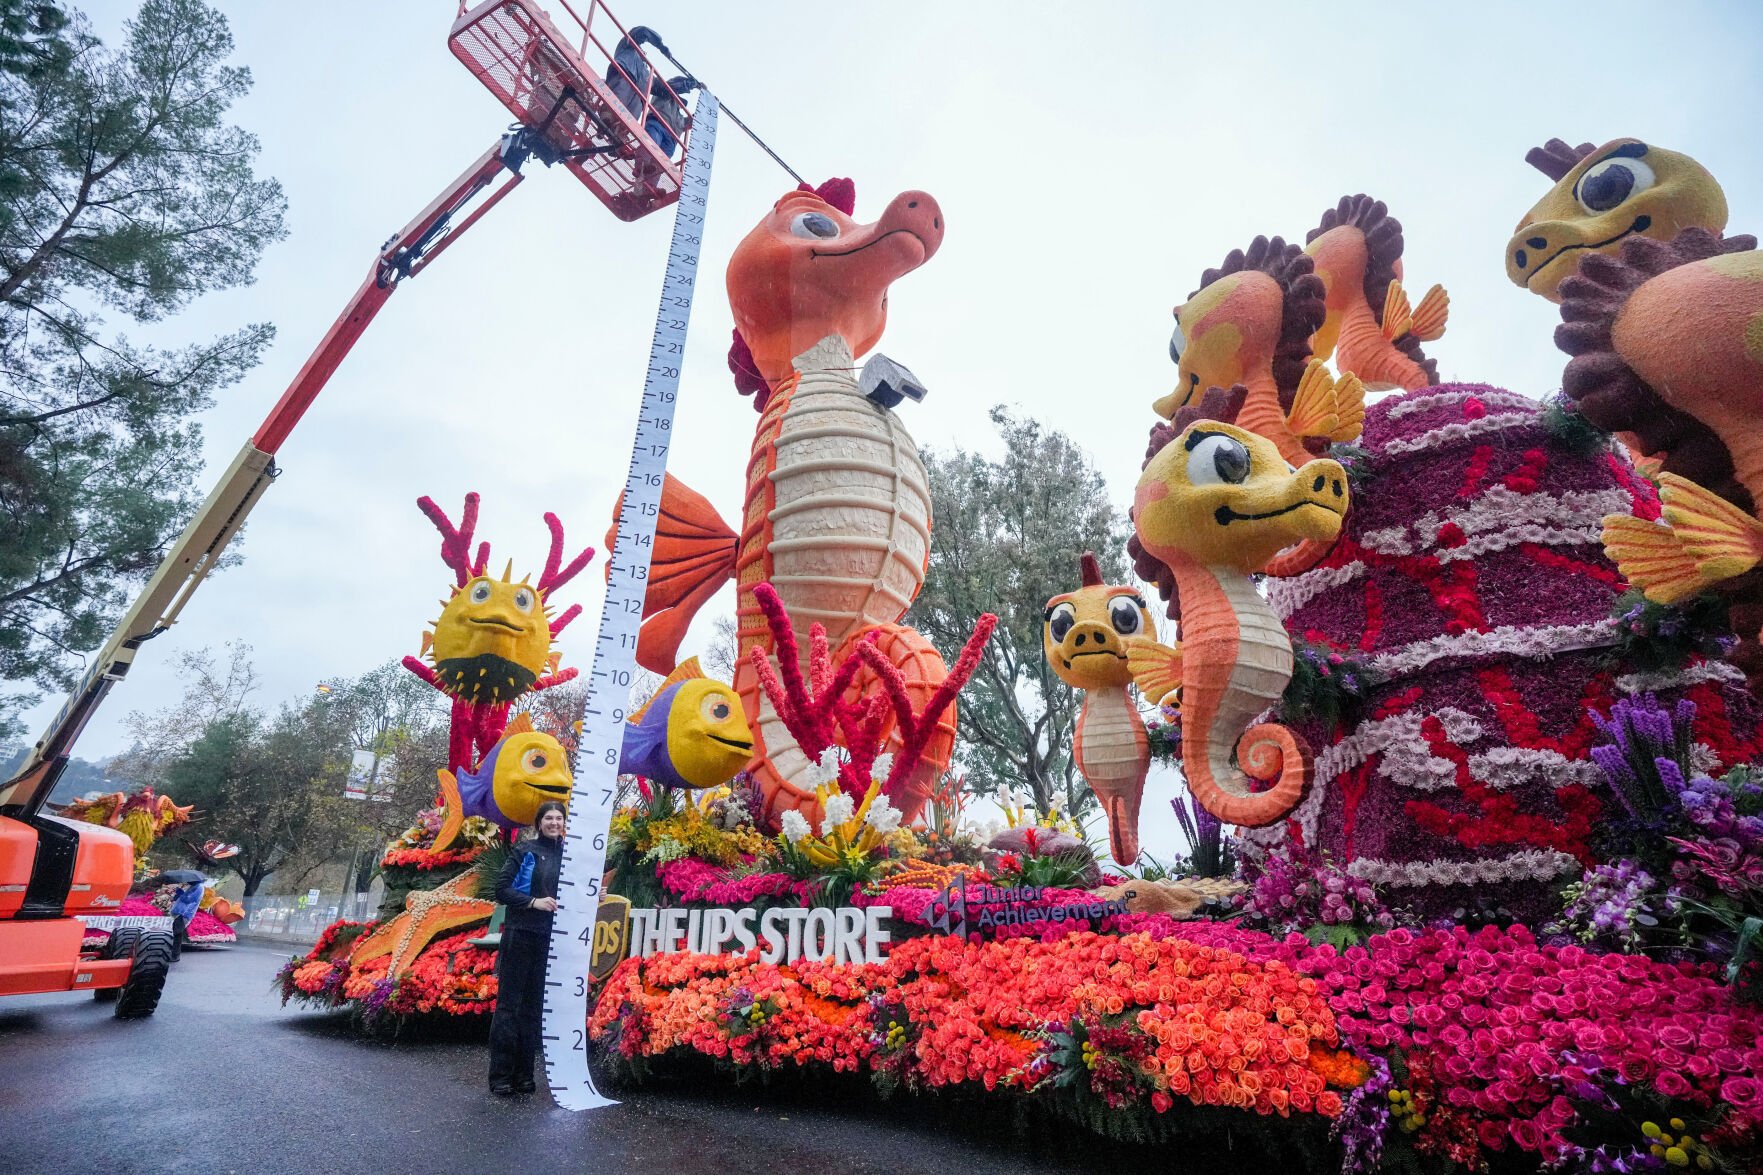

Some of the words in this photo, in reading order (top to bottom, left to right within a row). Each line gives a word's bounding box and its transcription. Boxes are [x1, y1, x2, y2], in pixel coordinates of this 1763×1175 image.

[708, 108, 717, 118] 33
[703, 124, 715, 134] 32
[703, 141, 713, 152] 31
[698, 159, 710, 169] 30
[695, 176, 708, 186] 29
[691, 196, 705, 206] 28
[689, 214, 703, 224] 27
[685, 234, 699, 245] 26
[683, 254, 696, 265] 25
[678, 275, 692, 286] 24
[674, 297, 689, 308] 23
[670, 320, 685, 330] 22
[668, 343, 682, 354] 21
[662, 367, 678, 378] 20
[660, 392, 674, 403] 19
[655, 418, 670, 430] 18
[651, 445, 667, 457] 17
[645, 474, 661, 486] 16
[641, 503, 657, 516] 15
[634, 534, 651, 547] 14
[630, 565, 646, 580] 13
[624, 599, 641, 614] 12
[621, 634, 636, 649] 11
[612, 670, 629, 686] 10
[612, 709, 623, 724] 9
[605, 749, 616, 764] 8
[601, 789, 612, 806] 7
[593, 834, 604, 850] 6
[586, 878, 599, 897] 5
[975, 884, 1044, 904] Junior
[978, 898, 1130, 927] Achievement
[86, 916, 114, 928] SING
[119, 916, 173, 929] TOGETHE
[578, 927, 590, 946] 4
[629, 908, 687, 958] THE
[687, 908, 757, 957] UPS
[760, 906, 893, 966] STORE
[591, 920, 621, 967] ps
[574, 977, 584, 996] 3
[573, 1030, 583, 1050] 2
[584, 1081, 595, 1095] 1
